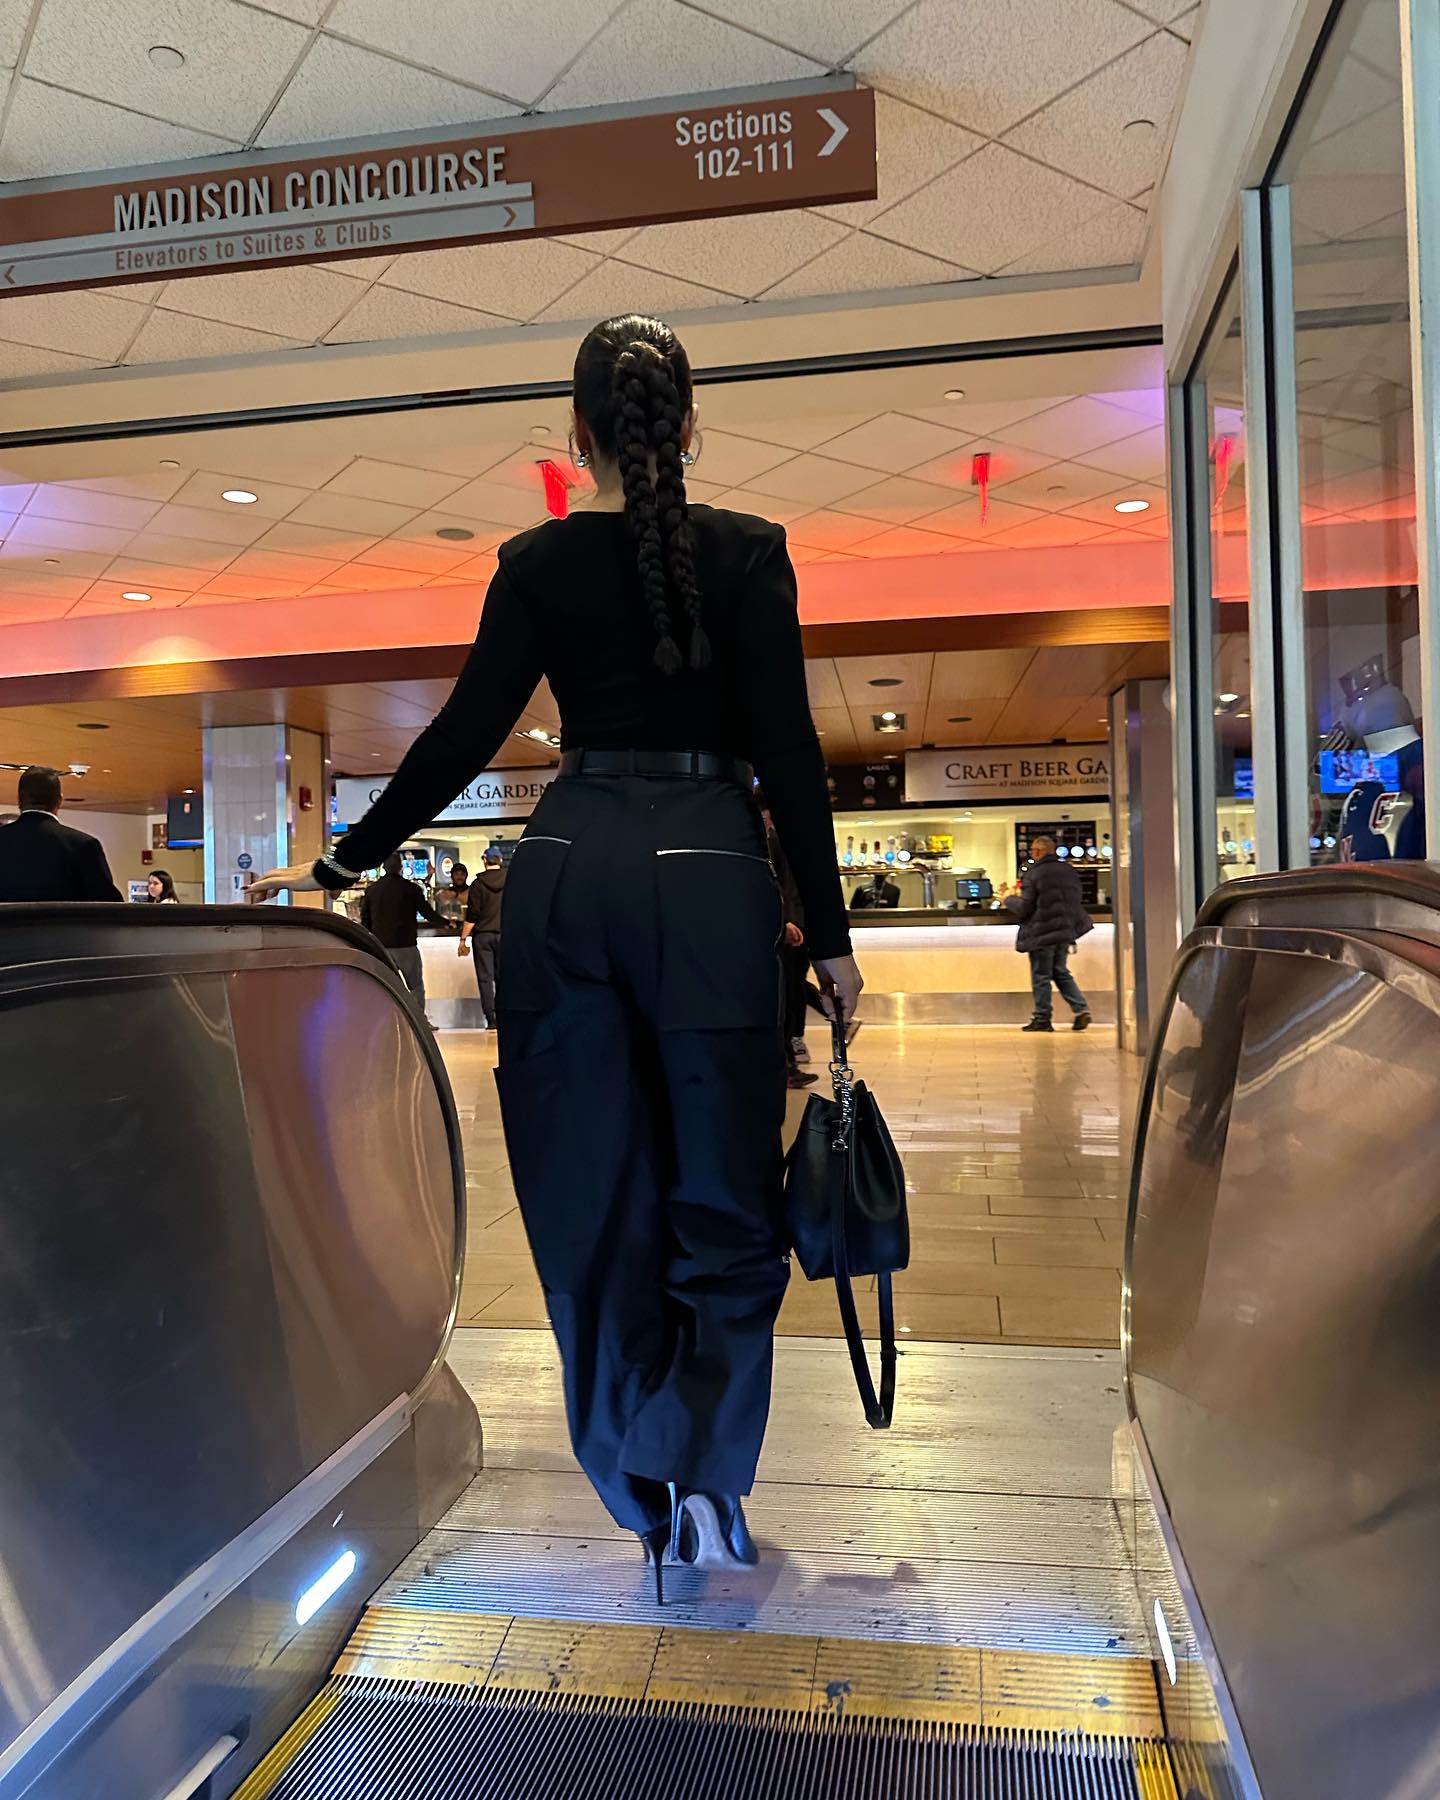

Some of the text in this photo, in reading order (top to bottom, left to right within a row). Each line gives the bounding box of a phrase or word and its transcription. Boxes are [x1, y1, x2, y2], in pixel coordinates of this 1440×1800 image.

[675, 110, 793, 146] Sections
[693, 140, 794, 180] 102-111
[113, 146, 507, 232] MADISON CONCOURSE
[115, 220, 392, 271] Elevators to Suites & Clubs
